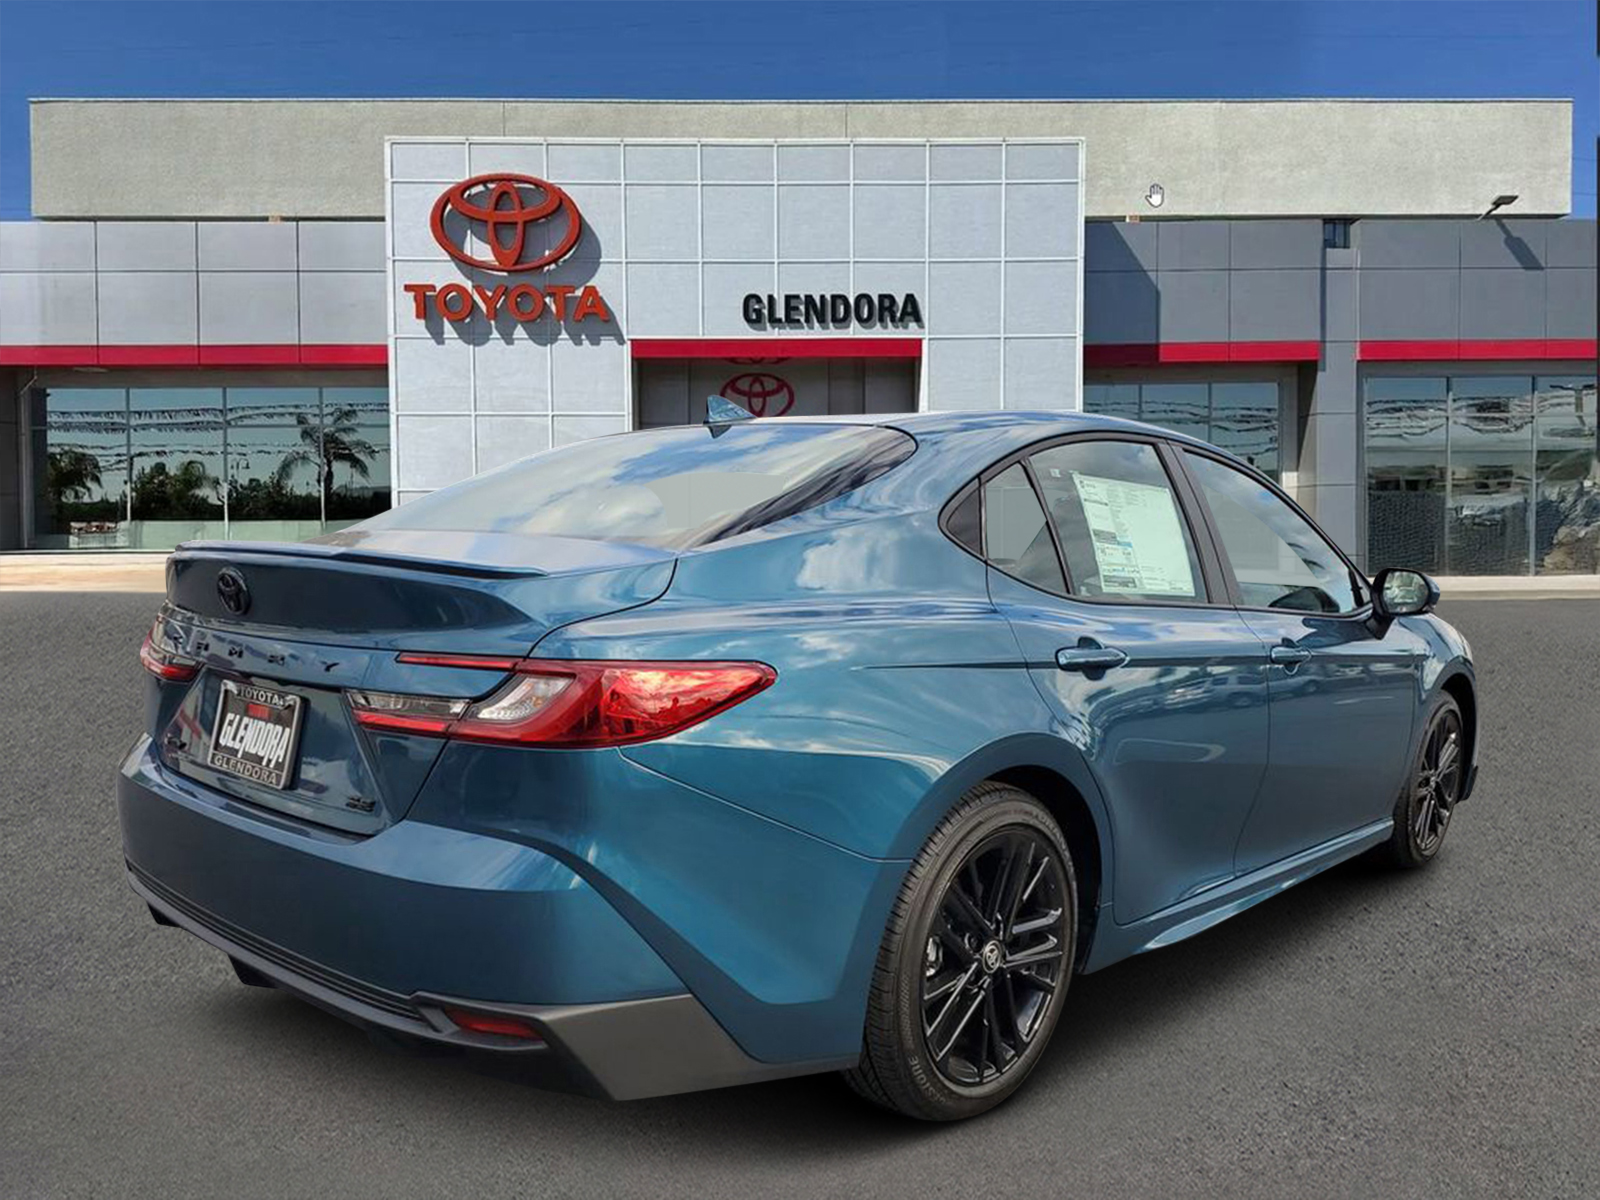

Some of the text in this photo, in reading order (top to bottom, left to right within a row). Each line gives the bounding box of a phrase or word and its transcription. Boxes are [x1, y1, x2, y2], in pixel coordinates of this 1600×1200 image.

[404, 283, 610, 322] TOYOTA
[742, 293, 922, 325] GLENDORA
[240, 687, 279, 705] TOYOTA
[219, 713, 291, 769] GLENDORA
[213, 755, 277, 785] GLENDORA
